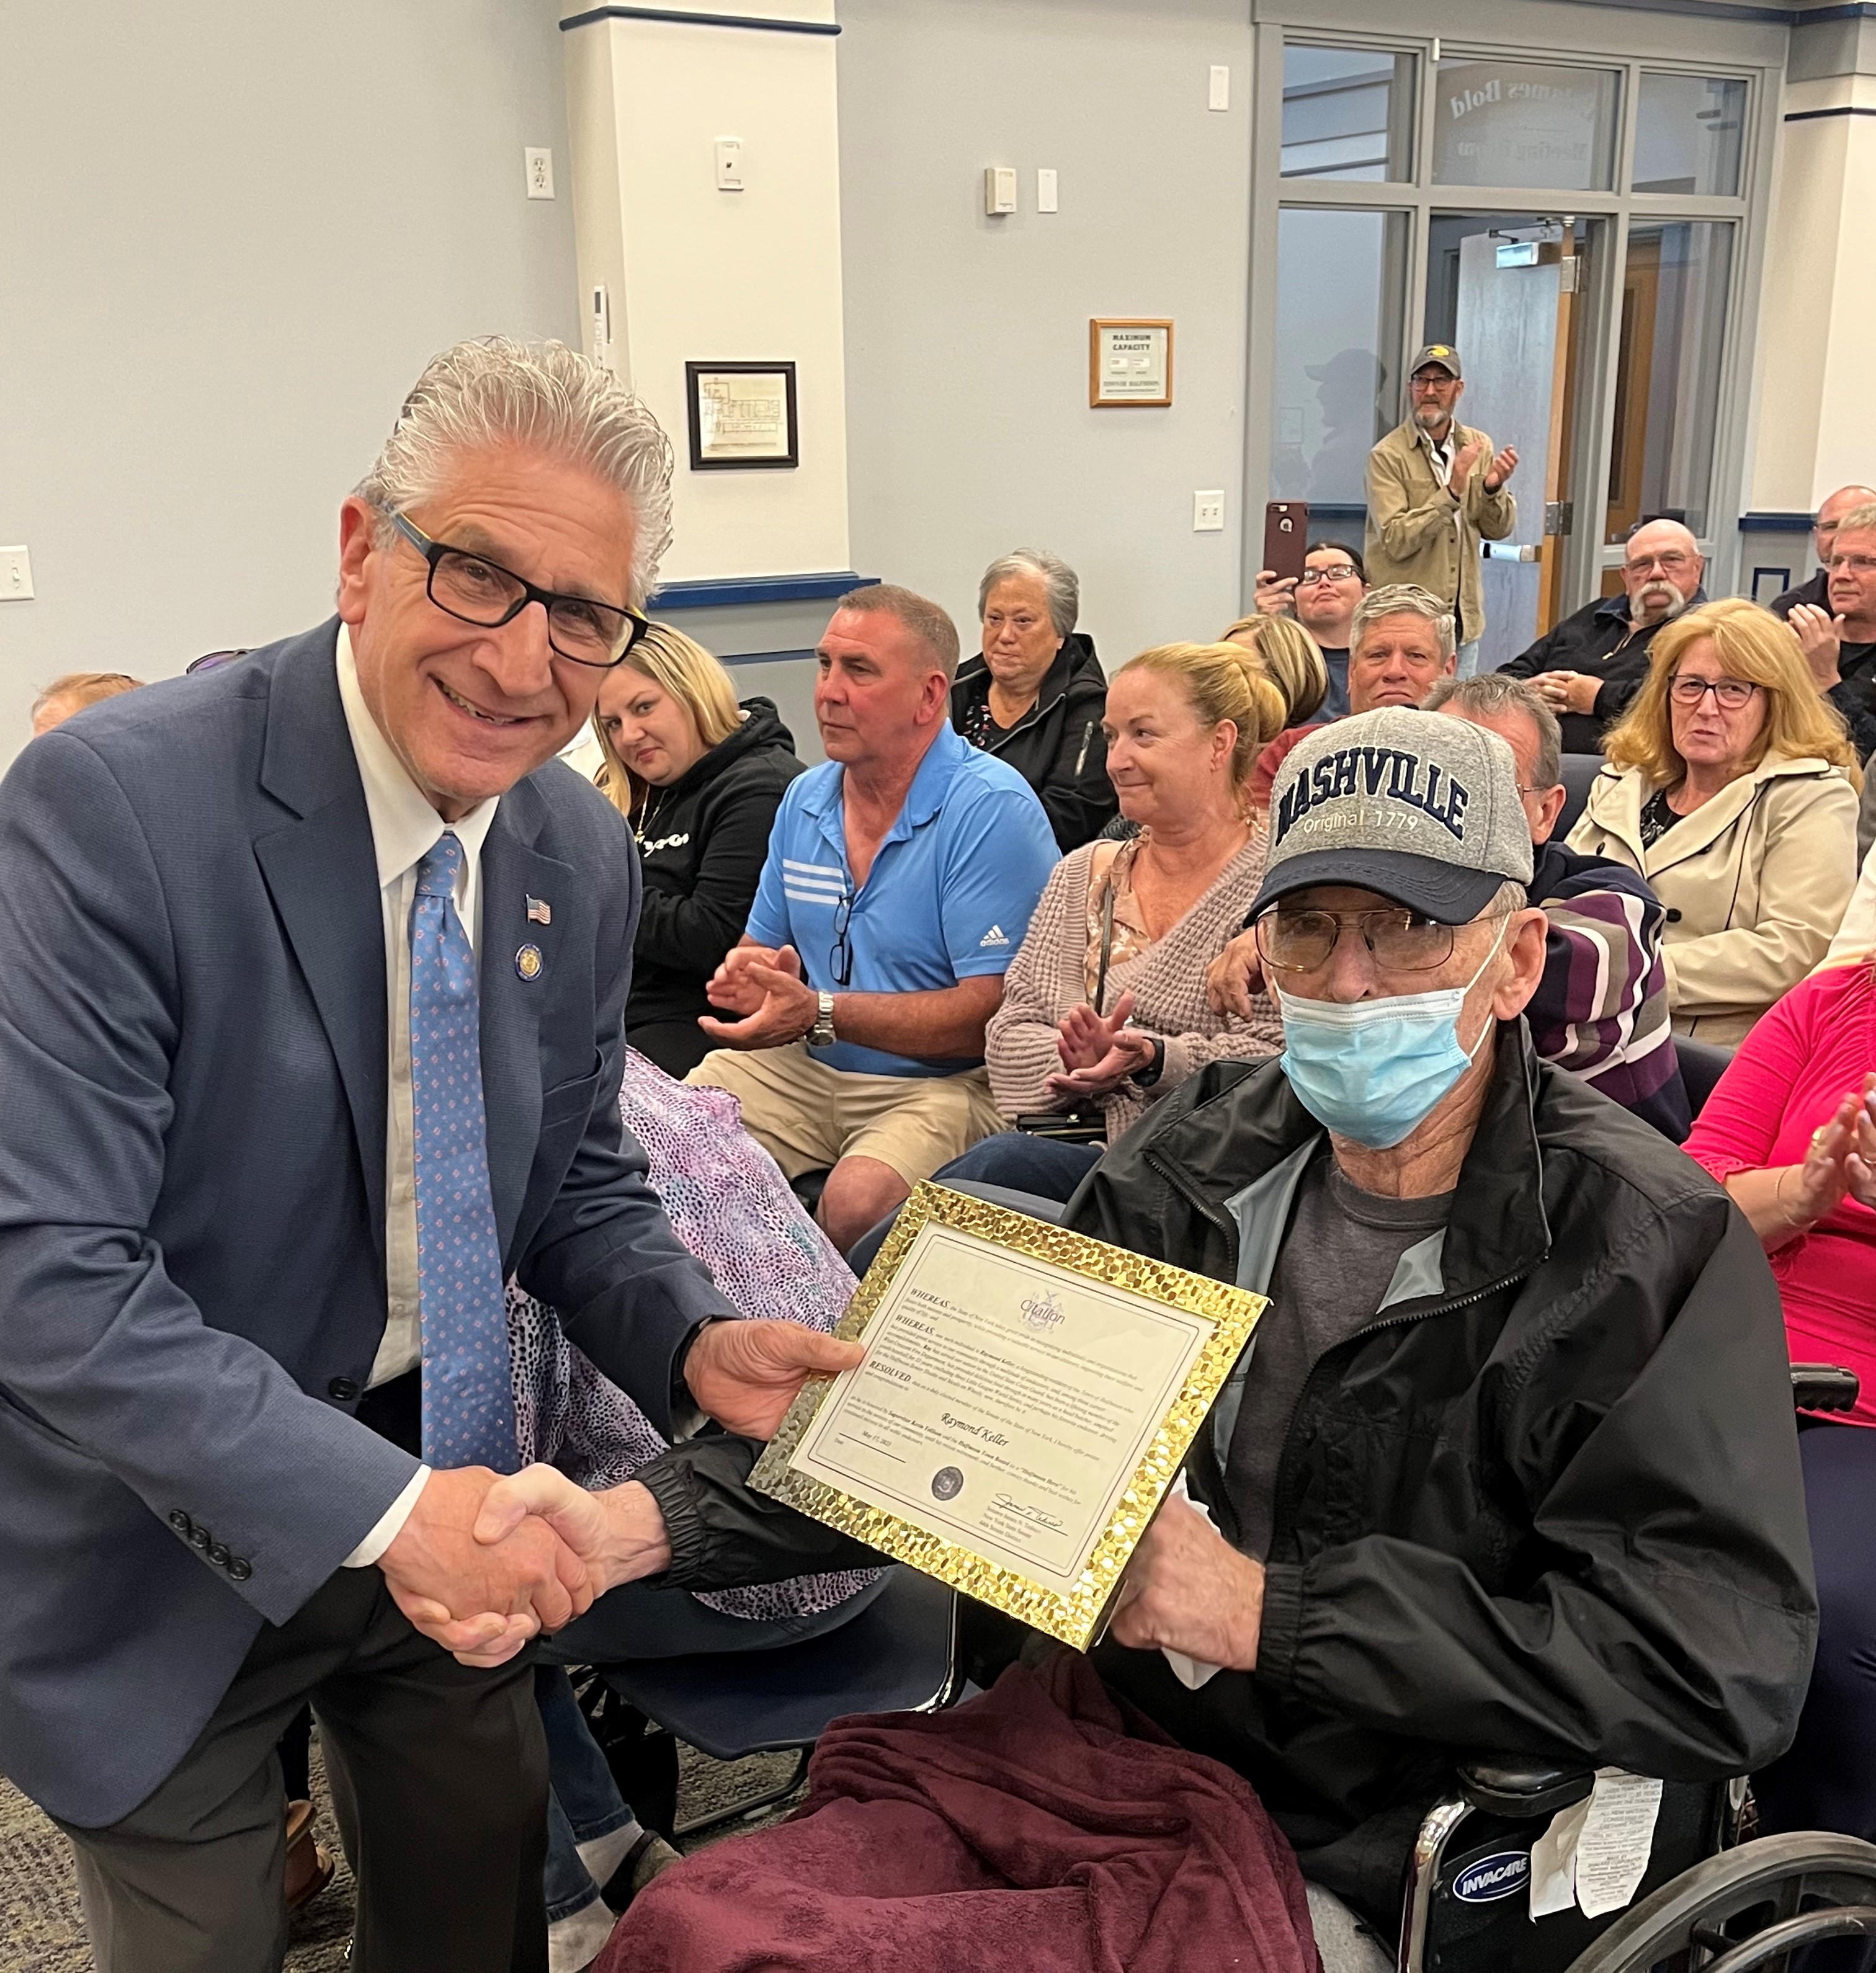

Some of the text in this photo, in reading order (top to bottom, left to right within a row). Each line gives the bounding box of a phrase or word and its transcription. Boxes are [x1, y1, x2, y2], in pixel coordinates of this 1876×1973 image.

[1275, 746, 1469, 847] NASHVILLE
[1374, 811, 1419, 831] 1779
[941, 1413, 985, 1435] Raymond
[981, 1429, 1009, 1446] Keller
[1462, 1856, 1528, 1895] INVACARE
